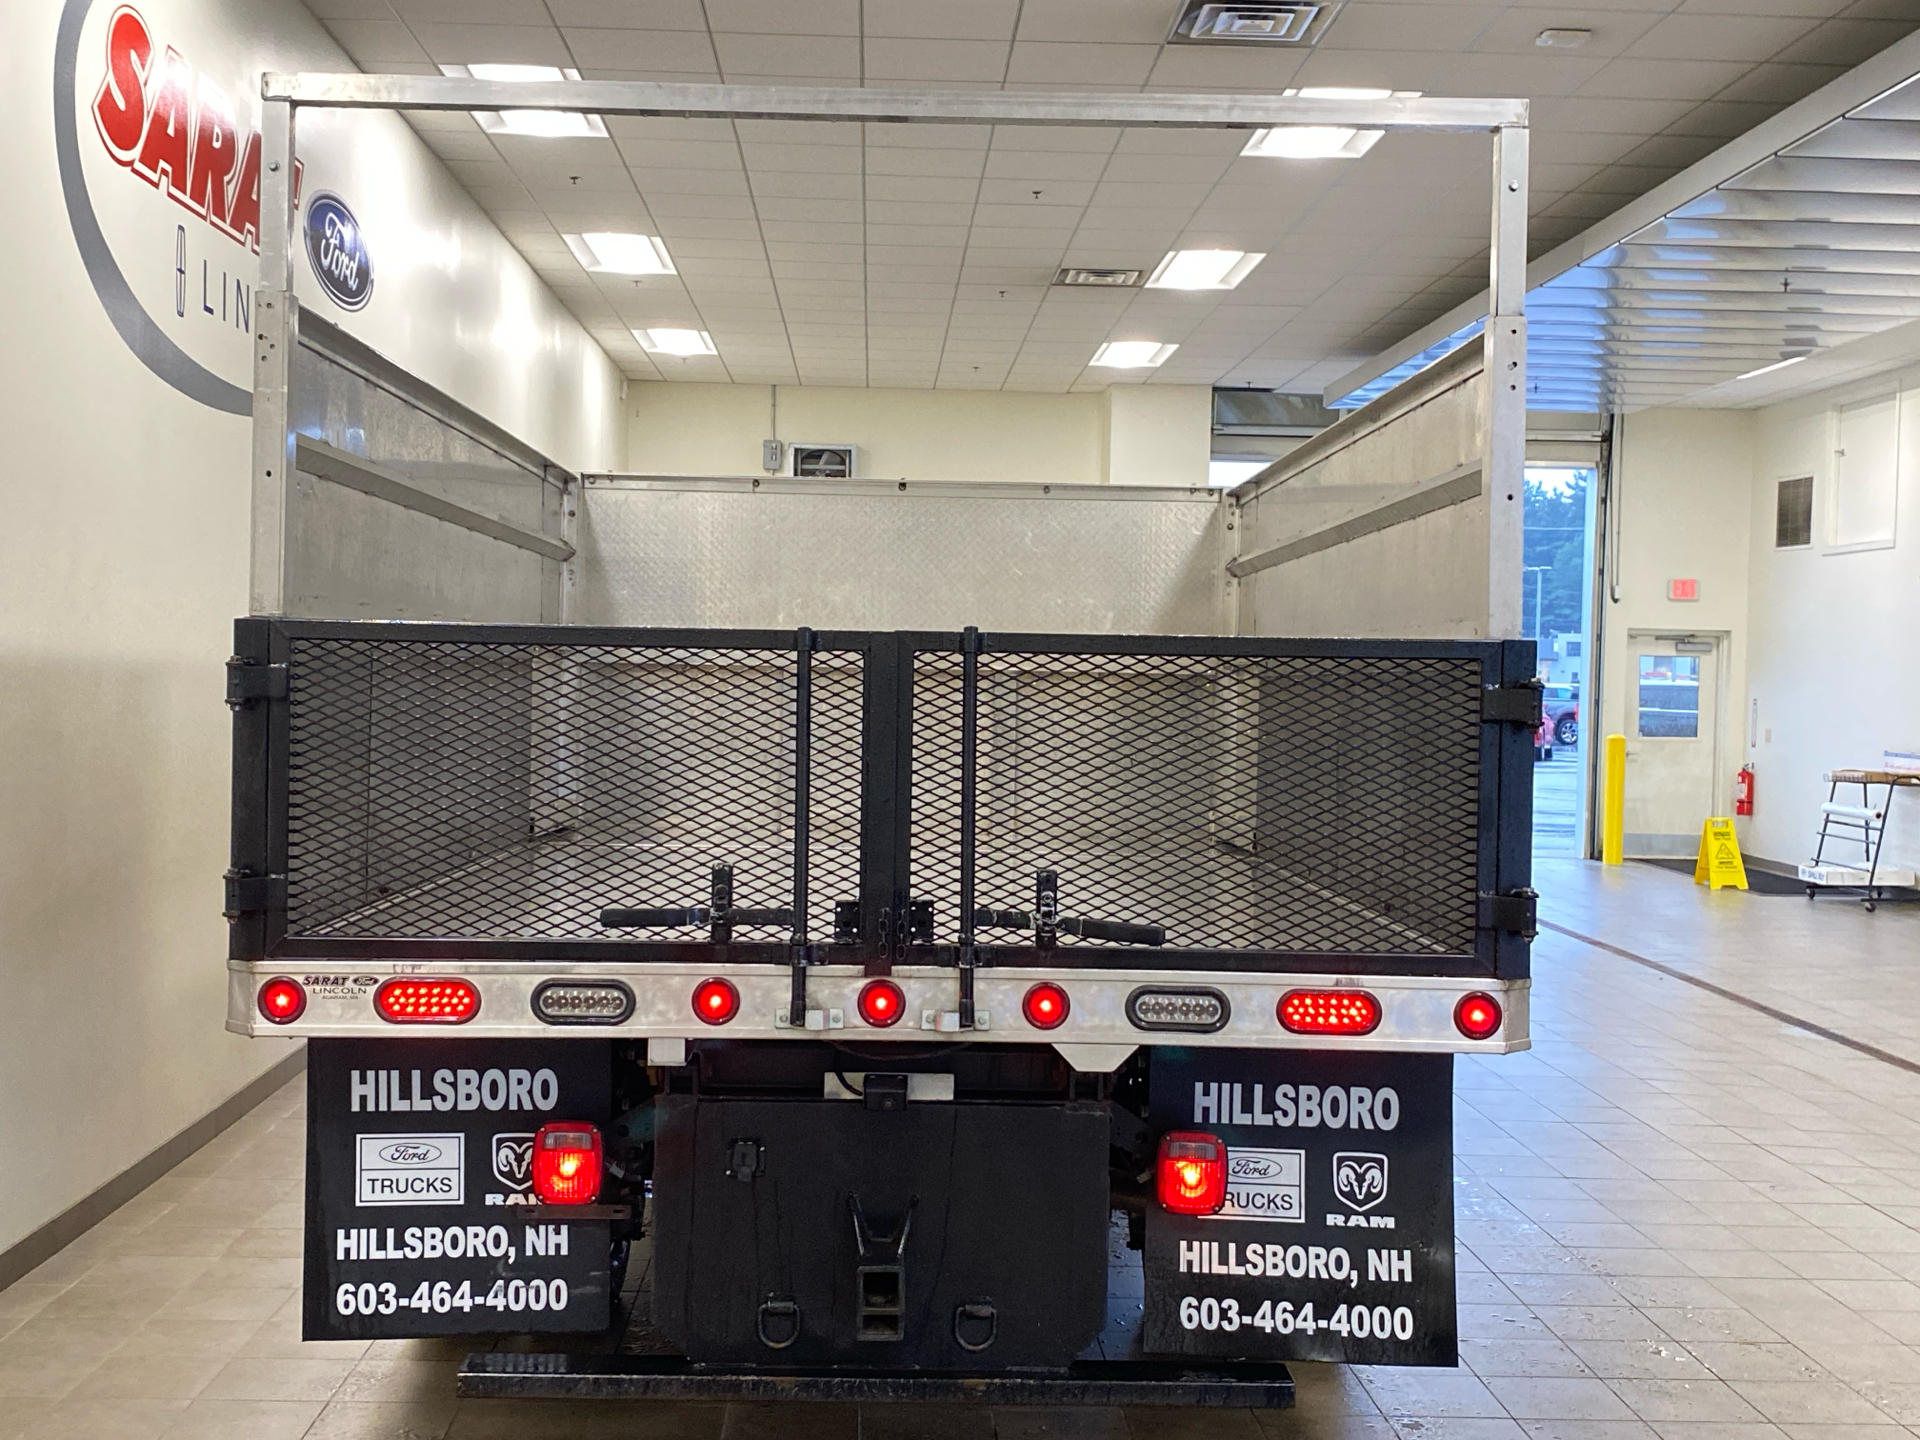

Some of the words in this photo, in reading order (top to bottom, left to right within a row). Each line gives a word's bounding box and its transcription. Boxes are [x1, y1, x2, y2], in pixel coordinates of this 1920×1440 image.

[91, 4, 304, 257] SARA
[320, 211, 360, 292] Ford
[203, 259, 250, 333] LIN
[1673, 579, 1698, 598] EXIT
[302, 975, 350, 987] SARAT
[350, 1068, 559, 1112] HILLSBORO
[1193, 1082, 1400, 1131] HILLSBORO
[391, 1145, 430, 1161] Ford
[1232, 1158, 1271, 1177] Ford
[367, 1177, 453, 1195] TRUCKS
[1224, 1191, 1293, 1211] RUCKS
[1326, 1214, 1395, 1229] RAM
[336, 1225, 516, 1264] HILLSBORO,
[525, 1225, 569, 1256] NH
[1179, 1240, 1358, 1288] HILLSBORO,
[1368, 1249, 1412, 1282] NH
[336, 1279, 569, 1316] 603-464-4000
[1180, 1296, 1413, 1340] 603-464-4000
